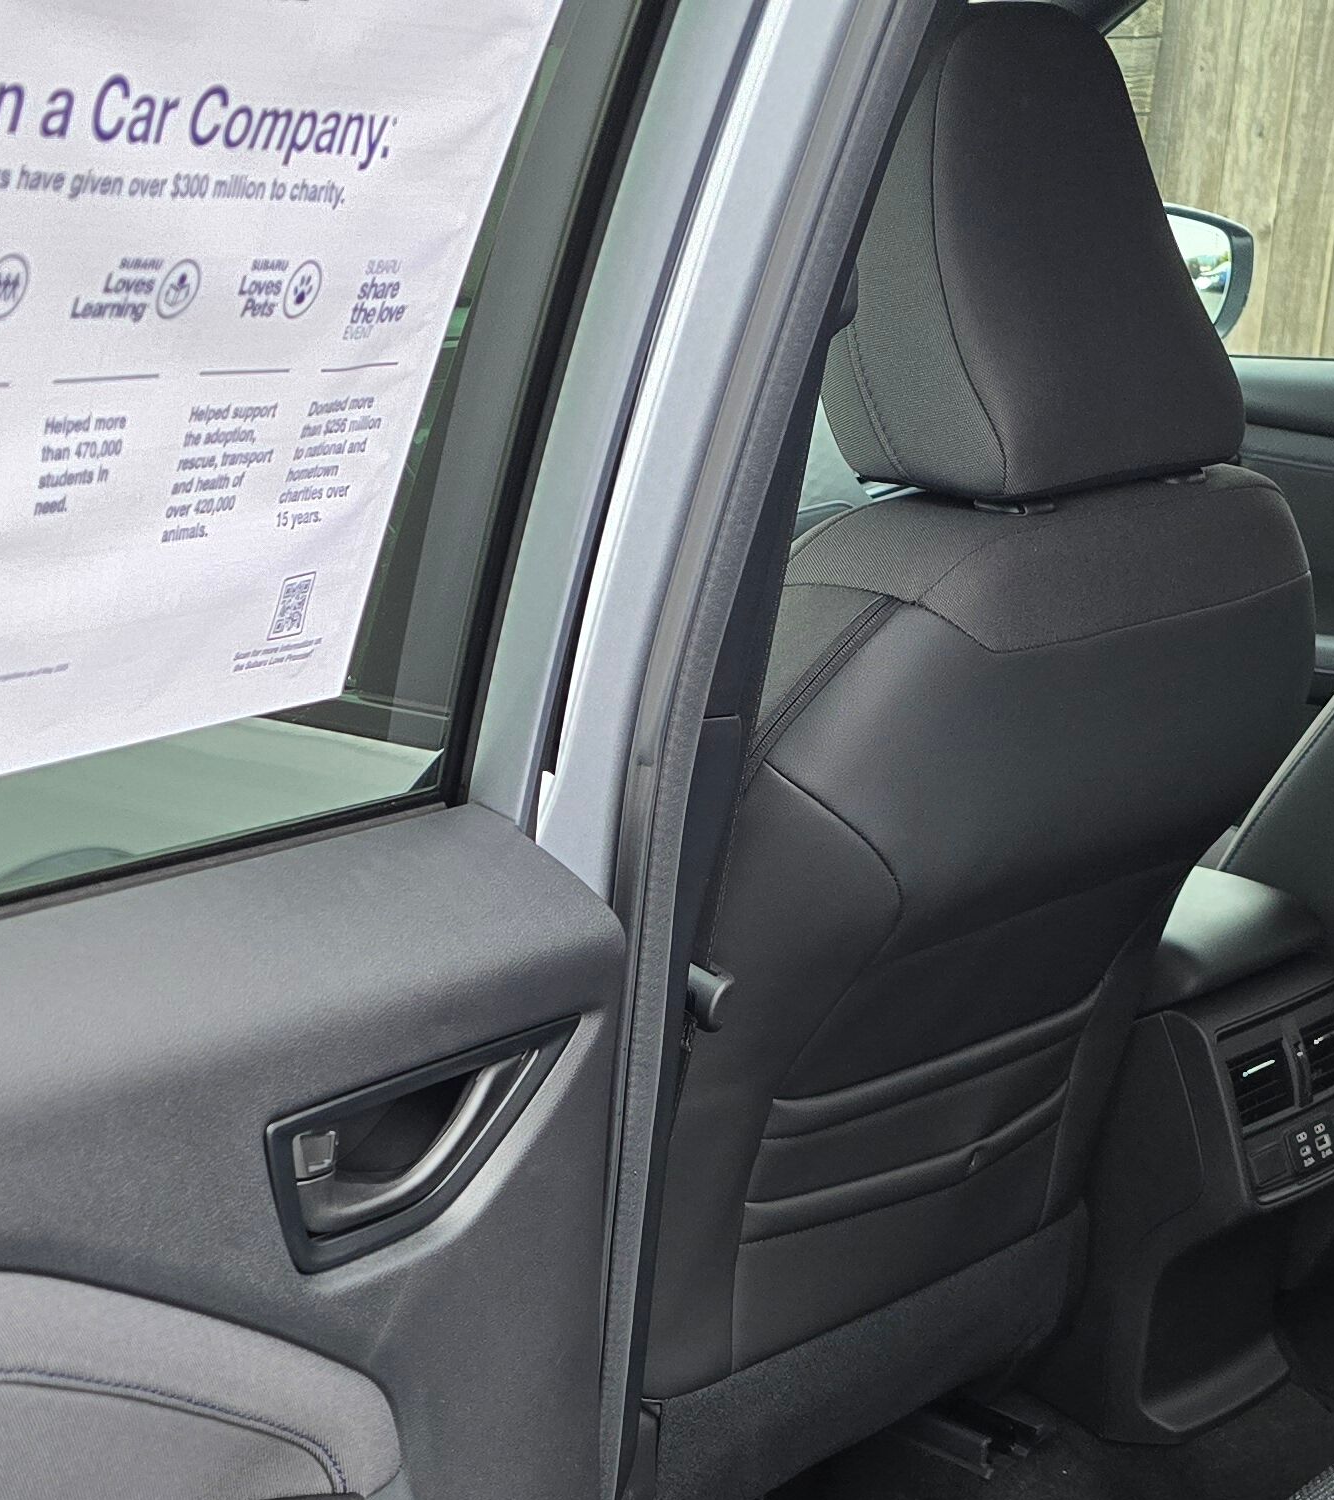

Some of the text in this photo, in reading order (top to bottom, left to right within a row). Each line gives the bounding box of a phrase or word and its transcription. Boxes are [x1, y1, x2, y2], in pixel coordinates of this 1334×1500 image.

[40, 87, 74, 139] a
[92, 73, 180, 145] Car
[15, 165, 65, 192] have
[68, 171, 124, 200] given
[128, 177, 168, 199] over
[170, 172, 210, 199] $300
[212, 174, 267, 201] million
[269, 178, 286, 202] to
[290, 178, 346, 210] charity.
[365, 259, 402, 275] SUBARU
[103, 272, 155, 295] Loves
[238, 274, 283, 297] Loves
[357, 276, 401, 301] share
[70, 295, 148, 323] Learning
[240, 297, 276, 319] Pets
[349, 300, 406, 325] the love
[342, 324, 375, 342] EVENT
[188, 403, 278, 425] Helped support
[307, 395, 348, 417] Donated
[44, 412, 127, 438] Helped more
[300, 422, 322, 440] than
[348, 415, 382, 433] million
[183, 426, 256, 448] the adoption,
[304, 440, 346, 460] national
[347, 437, 368, 455] and
[41, 438, 123, 463] than 470,000
[177, 449, 274, 472] rescue, transport
[38, 468, 94, 489] students
[171, 471, 246, 495] and health of
[285, 463, 339, 483] hometown
[279, 483, 350, 504] charities over
[34, 495, 67, 516] need.
[166, 495, 236, 519] over 420,000
[290, 510, 322, 530] years.
[161, 522, 208, 543] animals.
